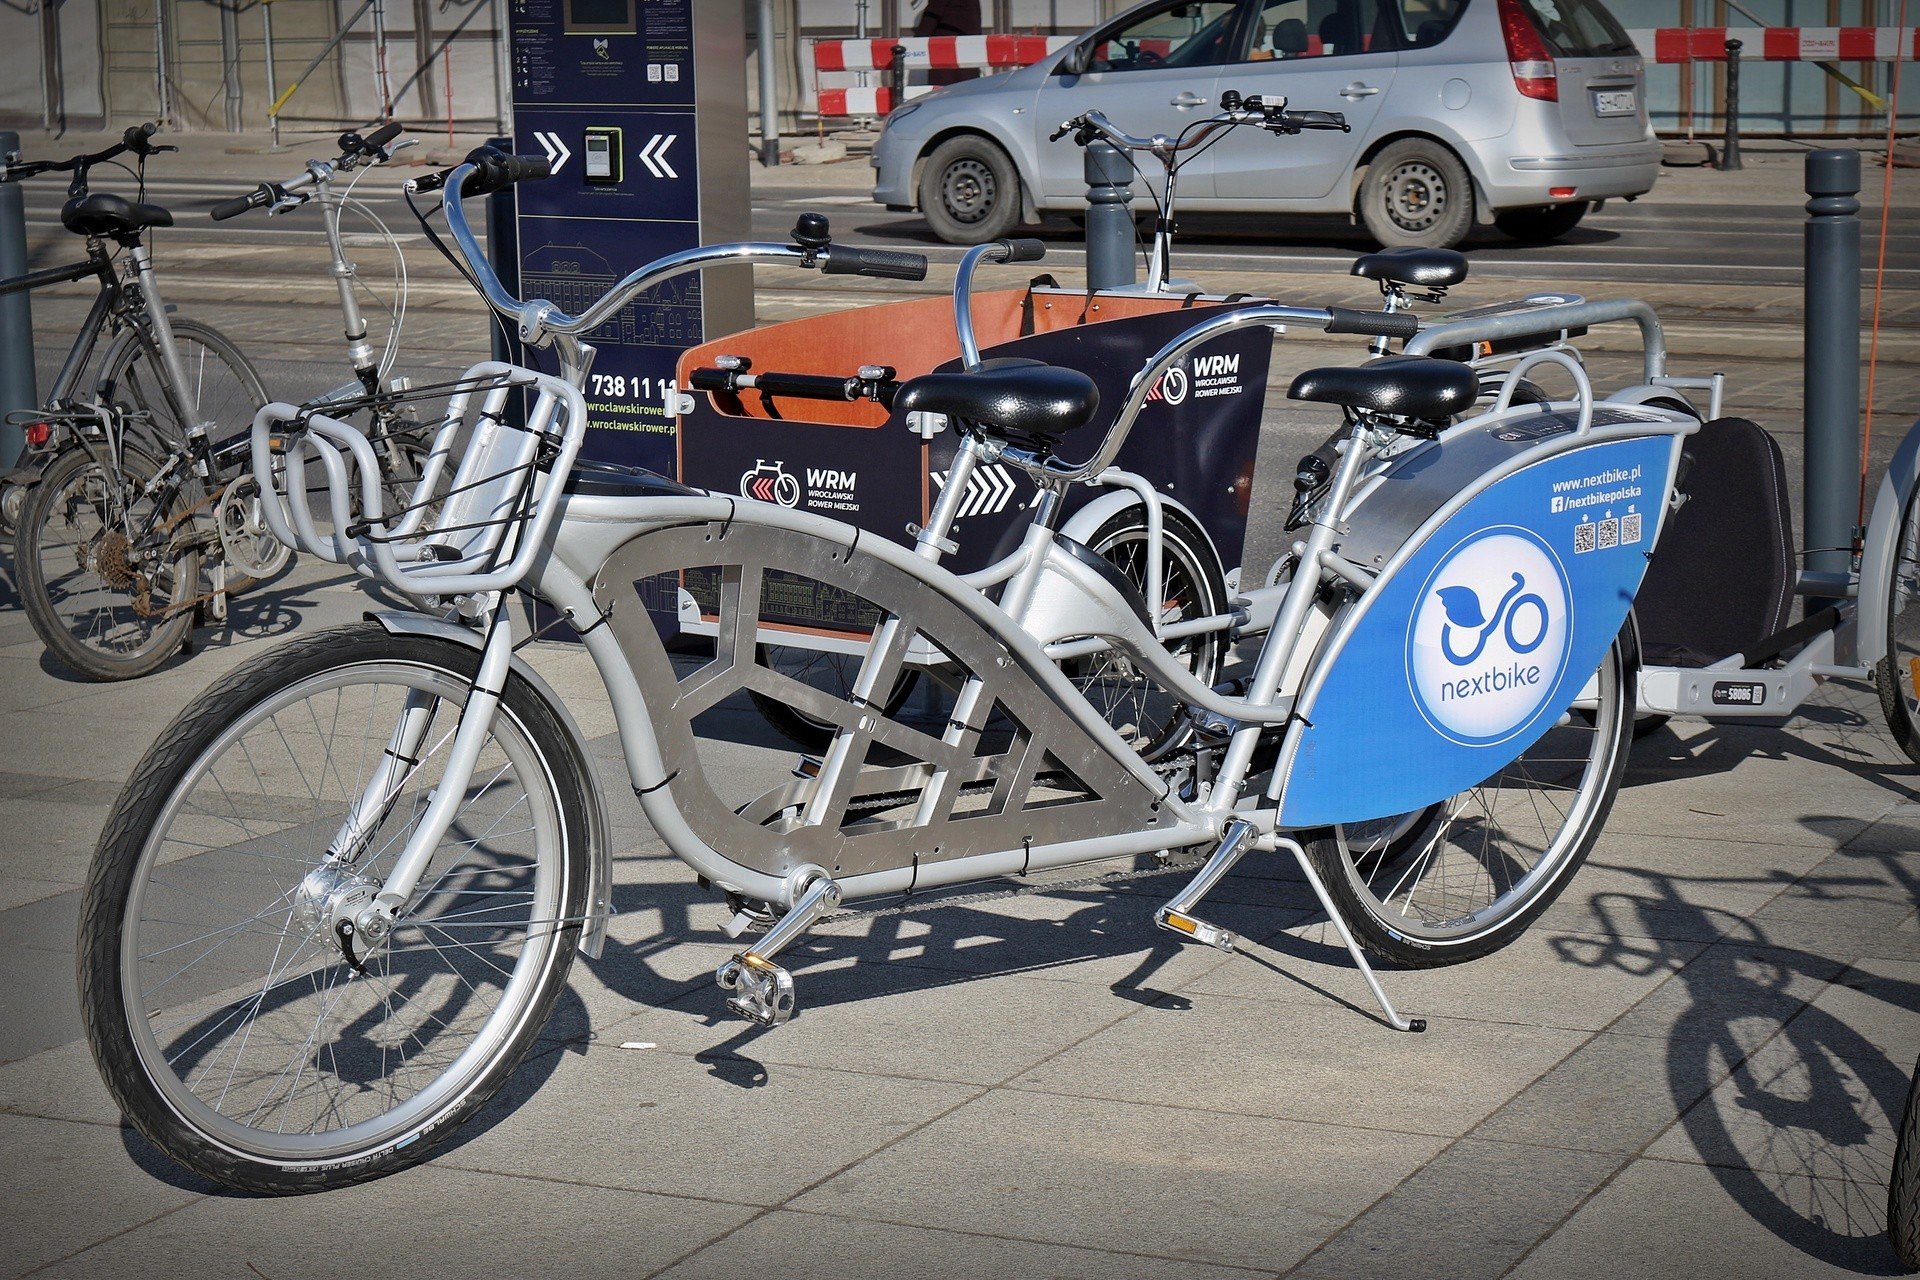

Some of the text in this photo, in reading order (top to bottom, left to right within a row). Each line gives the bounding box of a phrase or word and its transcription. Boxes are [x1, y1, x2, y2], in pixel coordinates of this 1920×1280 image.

[1194, 353, 1240, 377] WRM
[591, 374, 626, 397] 738
[630, 376, 650, 399] 11
[1195, 376, 1238, 388] WROCŁAWSKI
[1195, 385, 1243, 398] ROWER MIEJSKI
[806, 467, 857, 491] WRM
[1552, 464, 1642, 493] www.nextbike.pl
[808, 490, 854, 501] WROCŁAWSKI
[807, 500, 860, 511] ROWER MIEJSKI
[1441, 662, 1541, 702] nextbike
[1728, 687, 1752, 701] 58086
[422, 1098, 467, 1135] SCHWALBE
[371, 1146, 394, 1160] DELTA
[321, 1162, 341, 1171] PLUS
[342, 1156, 371, 1168] CRUISER
